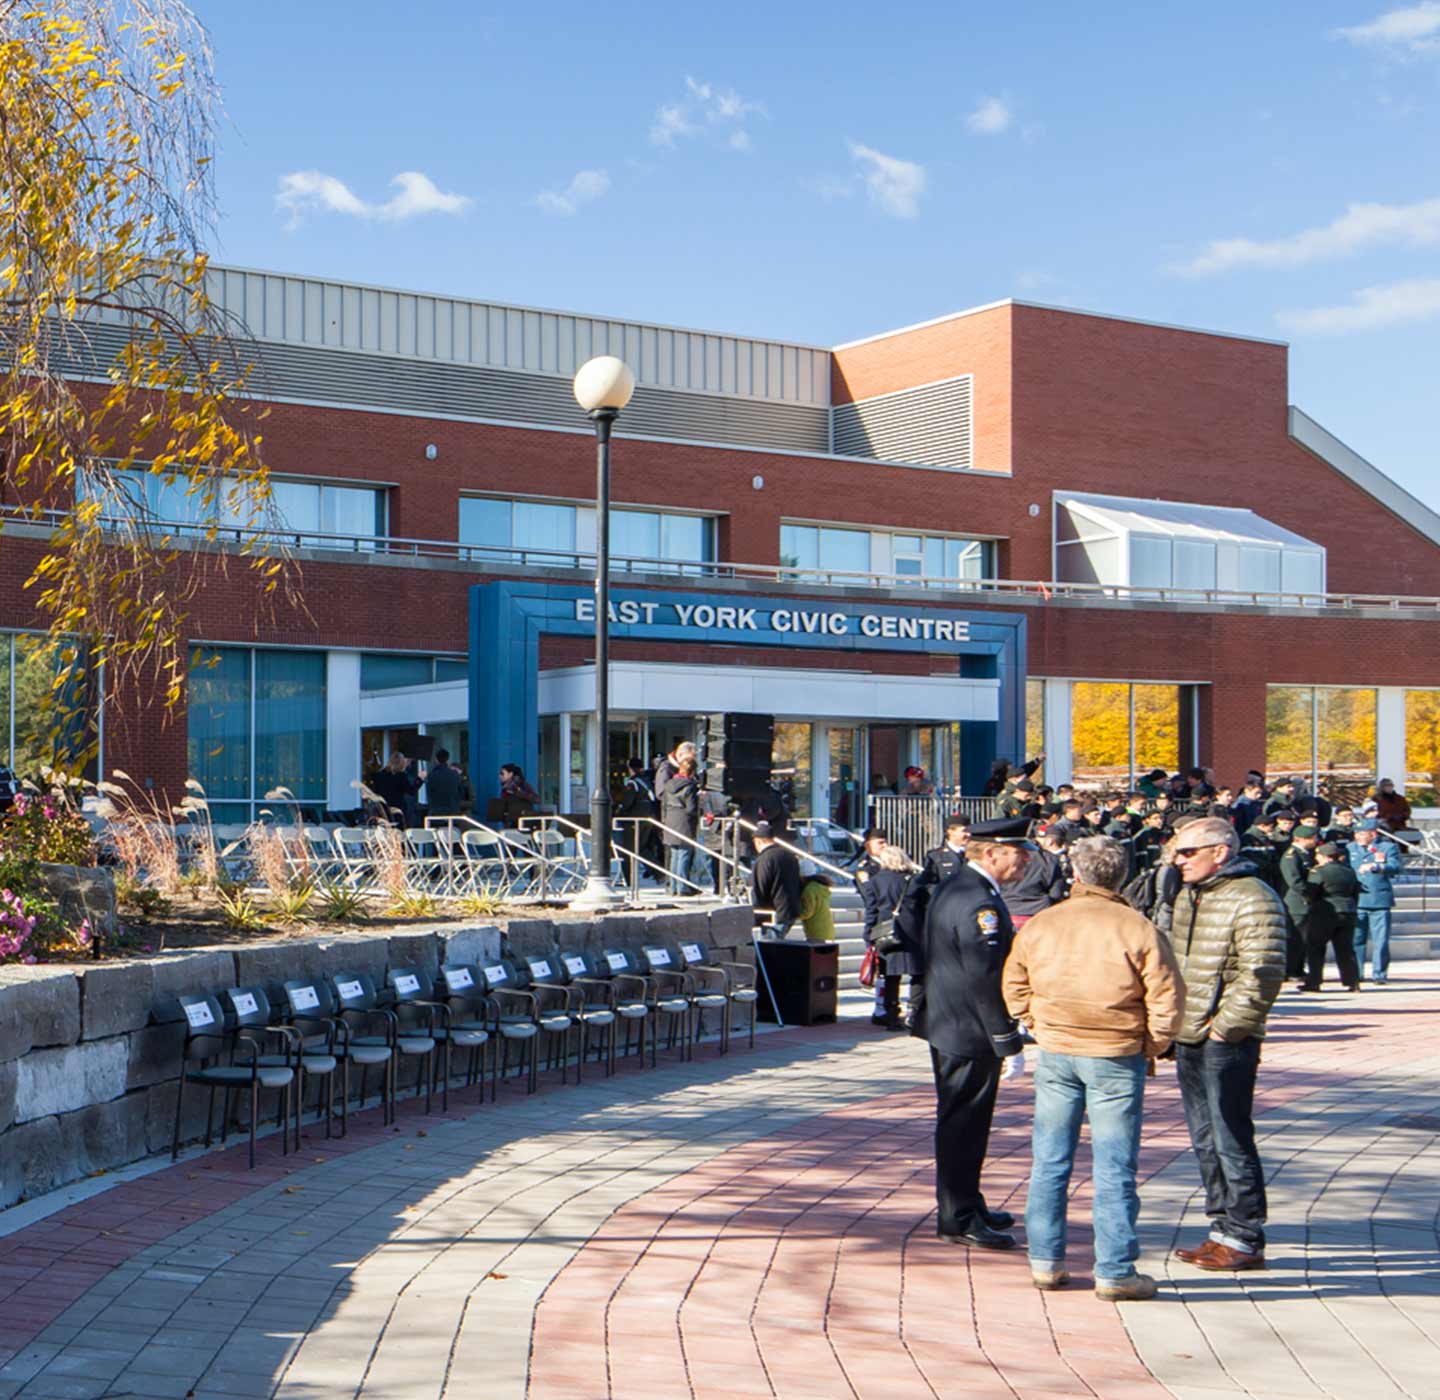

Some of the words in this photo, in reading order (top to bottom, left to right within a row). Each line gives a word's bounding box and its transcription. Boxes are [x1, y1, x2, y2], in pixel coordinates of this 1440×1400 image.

[575, 599, 659, 624] EAST
[675, 604, 757, 630] YORK
[771, 610, 848, 635] CIVIC
[861, 615, 971, 641] CENTRE
